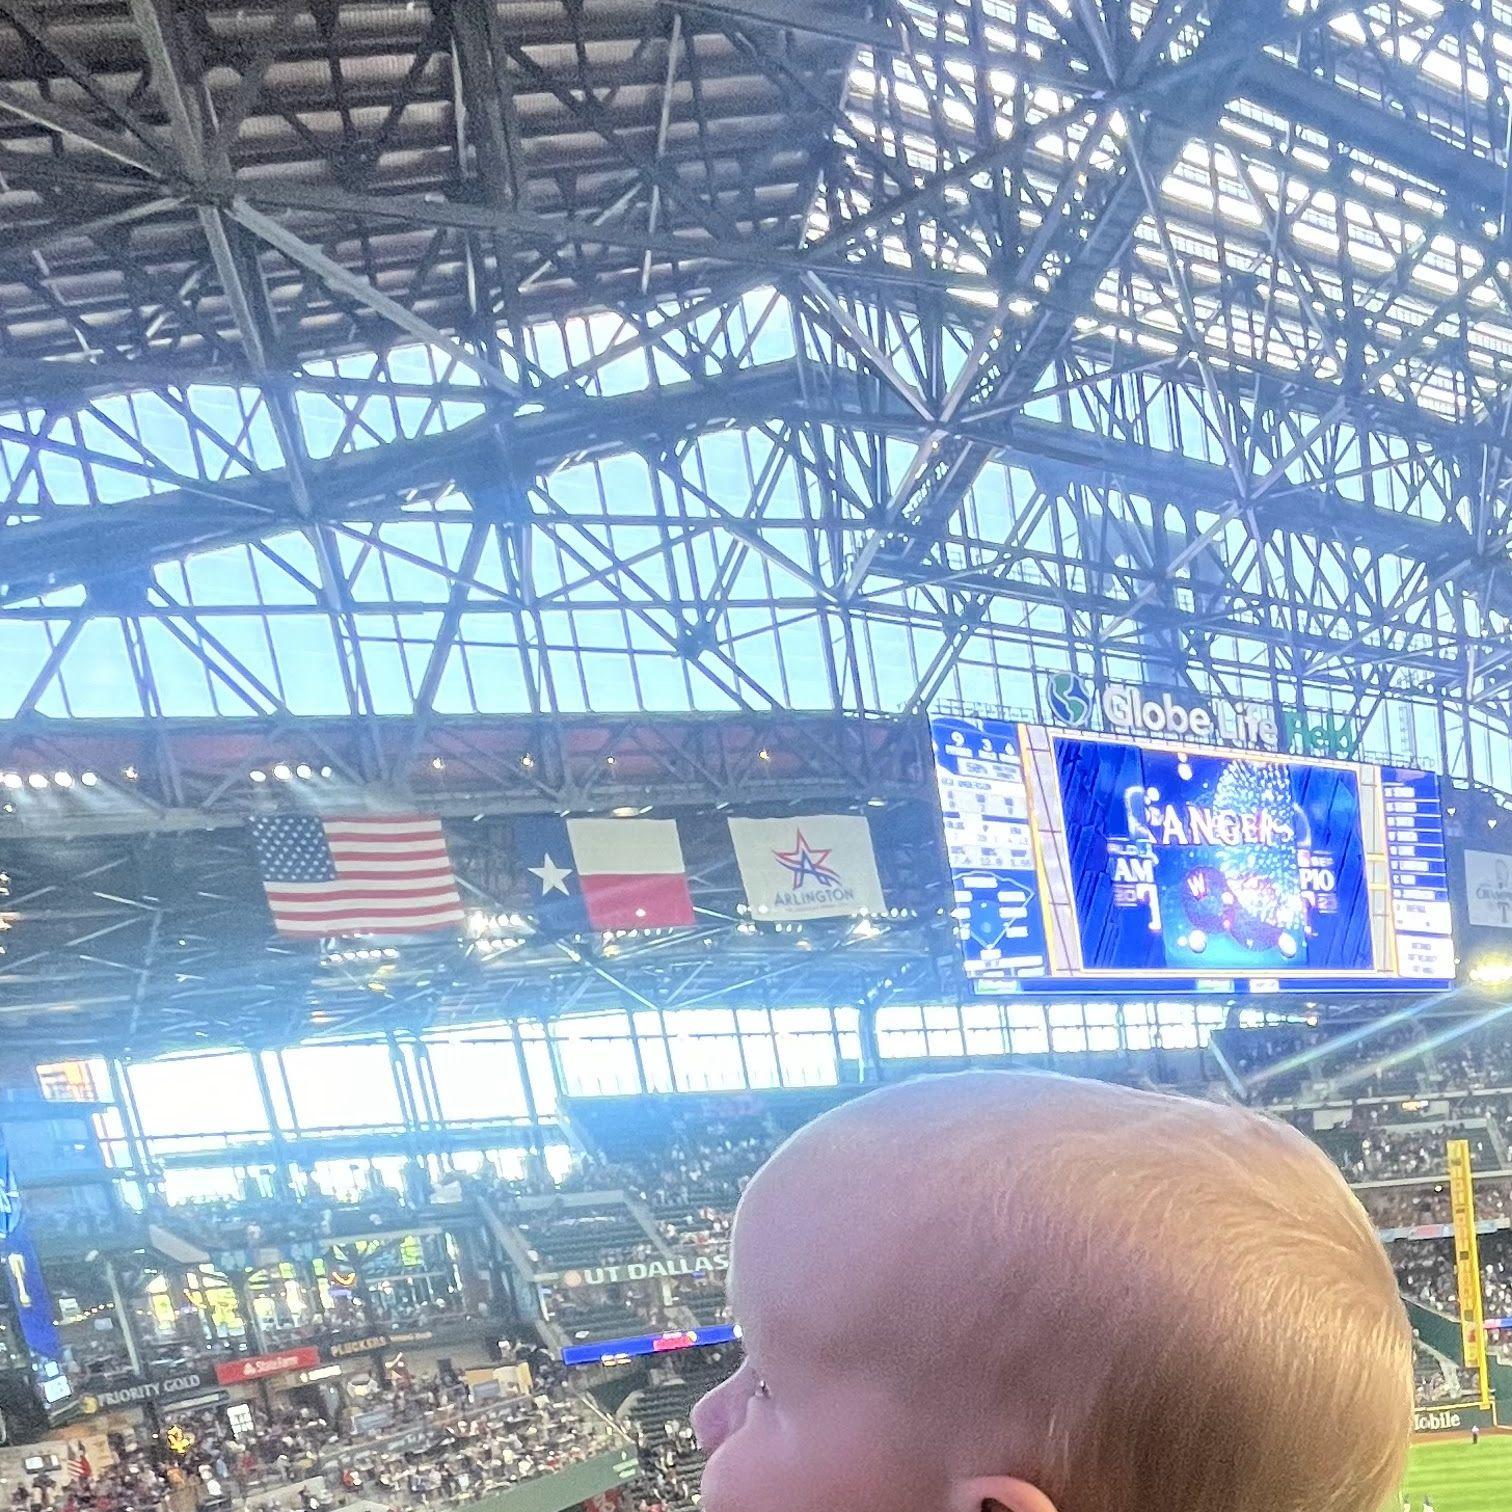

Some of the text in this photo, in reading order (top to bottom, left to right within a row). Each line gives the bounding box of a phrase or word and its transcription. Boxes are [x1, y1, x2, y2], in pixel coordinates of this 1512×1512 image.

[1103, 684, 1213, 737] Globe
[1213, 699, 1278, 749] Life
[774, 889, 854, 907] ARLINGTON
[584, 1254, 729, 1285] UT DALLAS
[98, 1375, 200, 1407] PRIORITY GOLD
